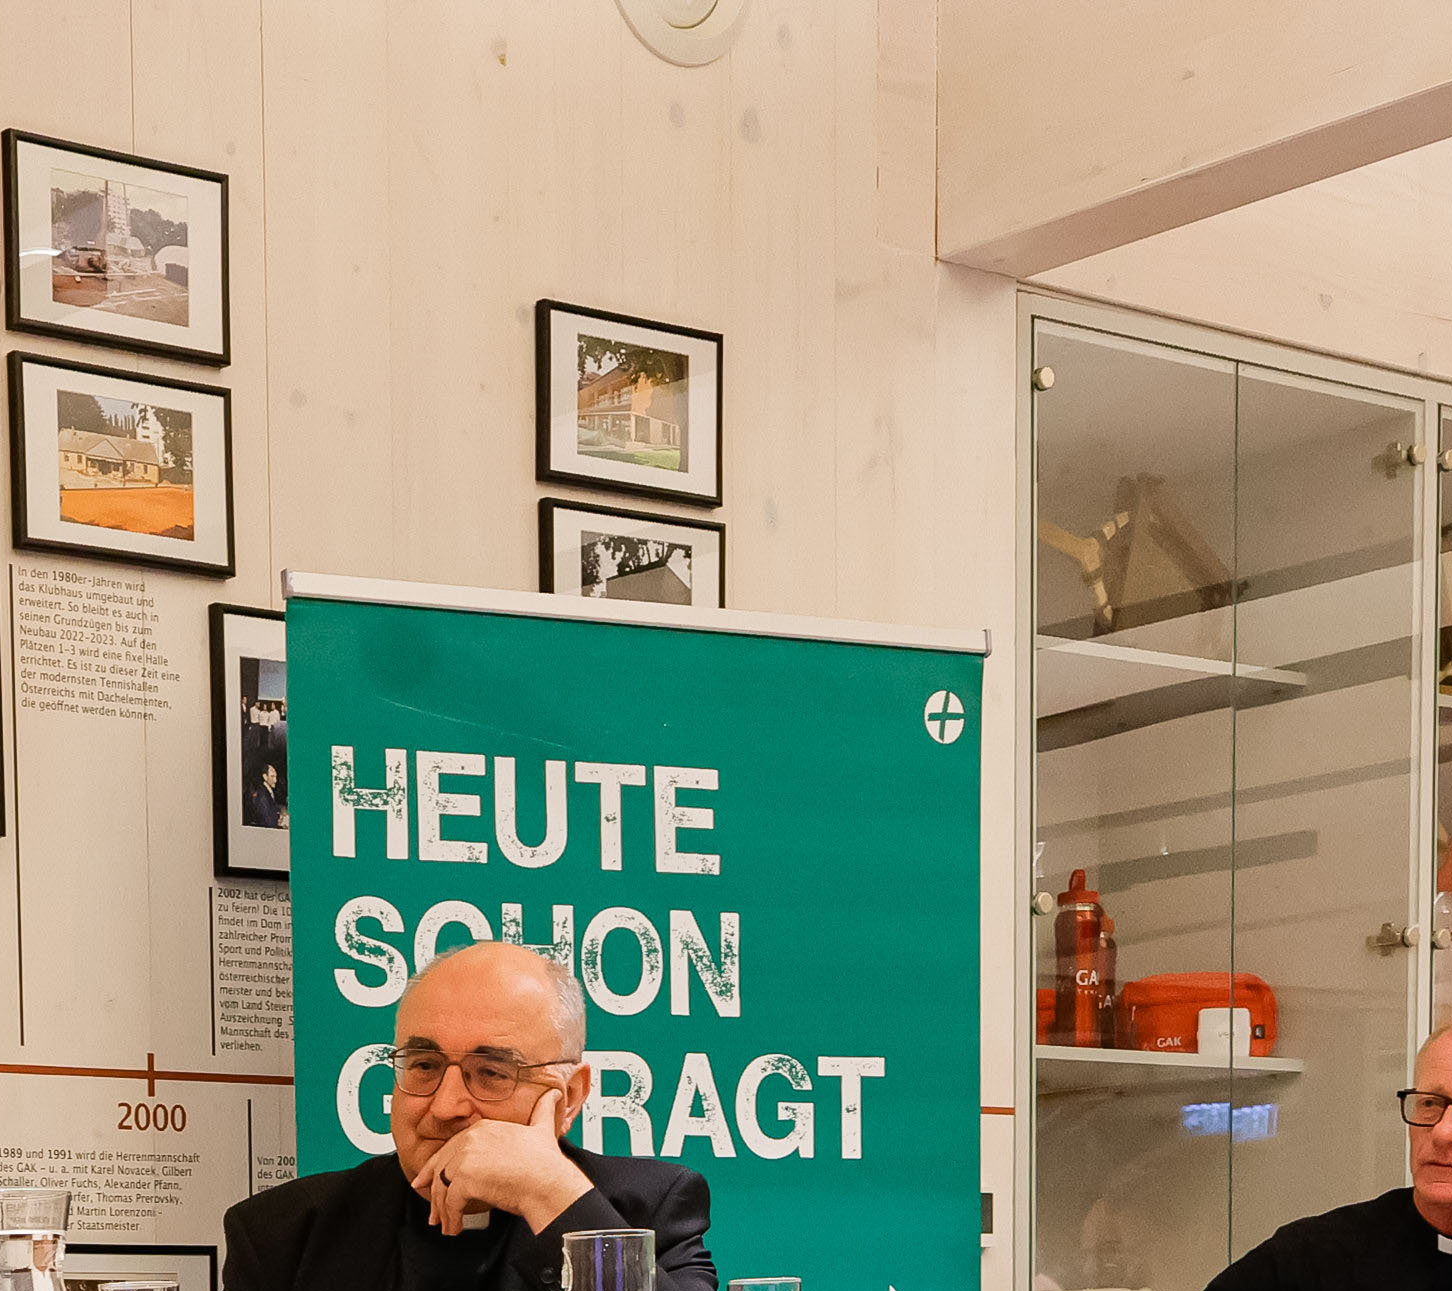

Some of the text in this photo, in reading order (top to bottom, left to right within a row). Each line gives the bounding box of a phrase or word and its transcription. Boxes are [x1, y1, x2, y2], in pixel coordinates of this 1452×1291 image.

[18, 566, 26, 578] In
[30, 567, 48, 581] den
[124, 579, 144, 592] wird
[331, 745, 720, 875] HEUTE
[333, 896, 741, 1017] SCHON
[1075, 969, 1099, 986] GA
[1156, 1036, 1182, 1048] GAK
[335, 1043, 885, 1159] GRAGT
[117, 1102, 187, 1132] 2000
[25, 1149, 43, 1159] und
[48, 1149, 71, 1160] 1991
[75, 1150, 95, 1160] wird
[98, 1150, 113, 1161] die
